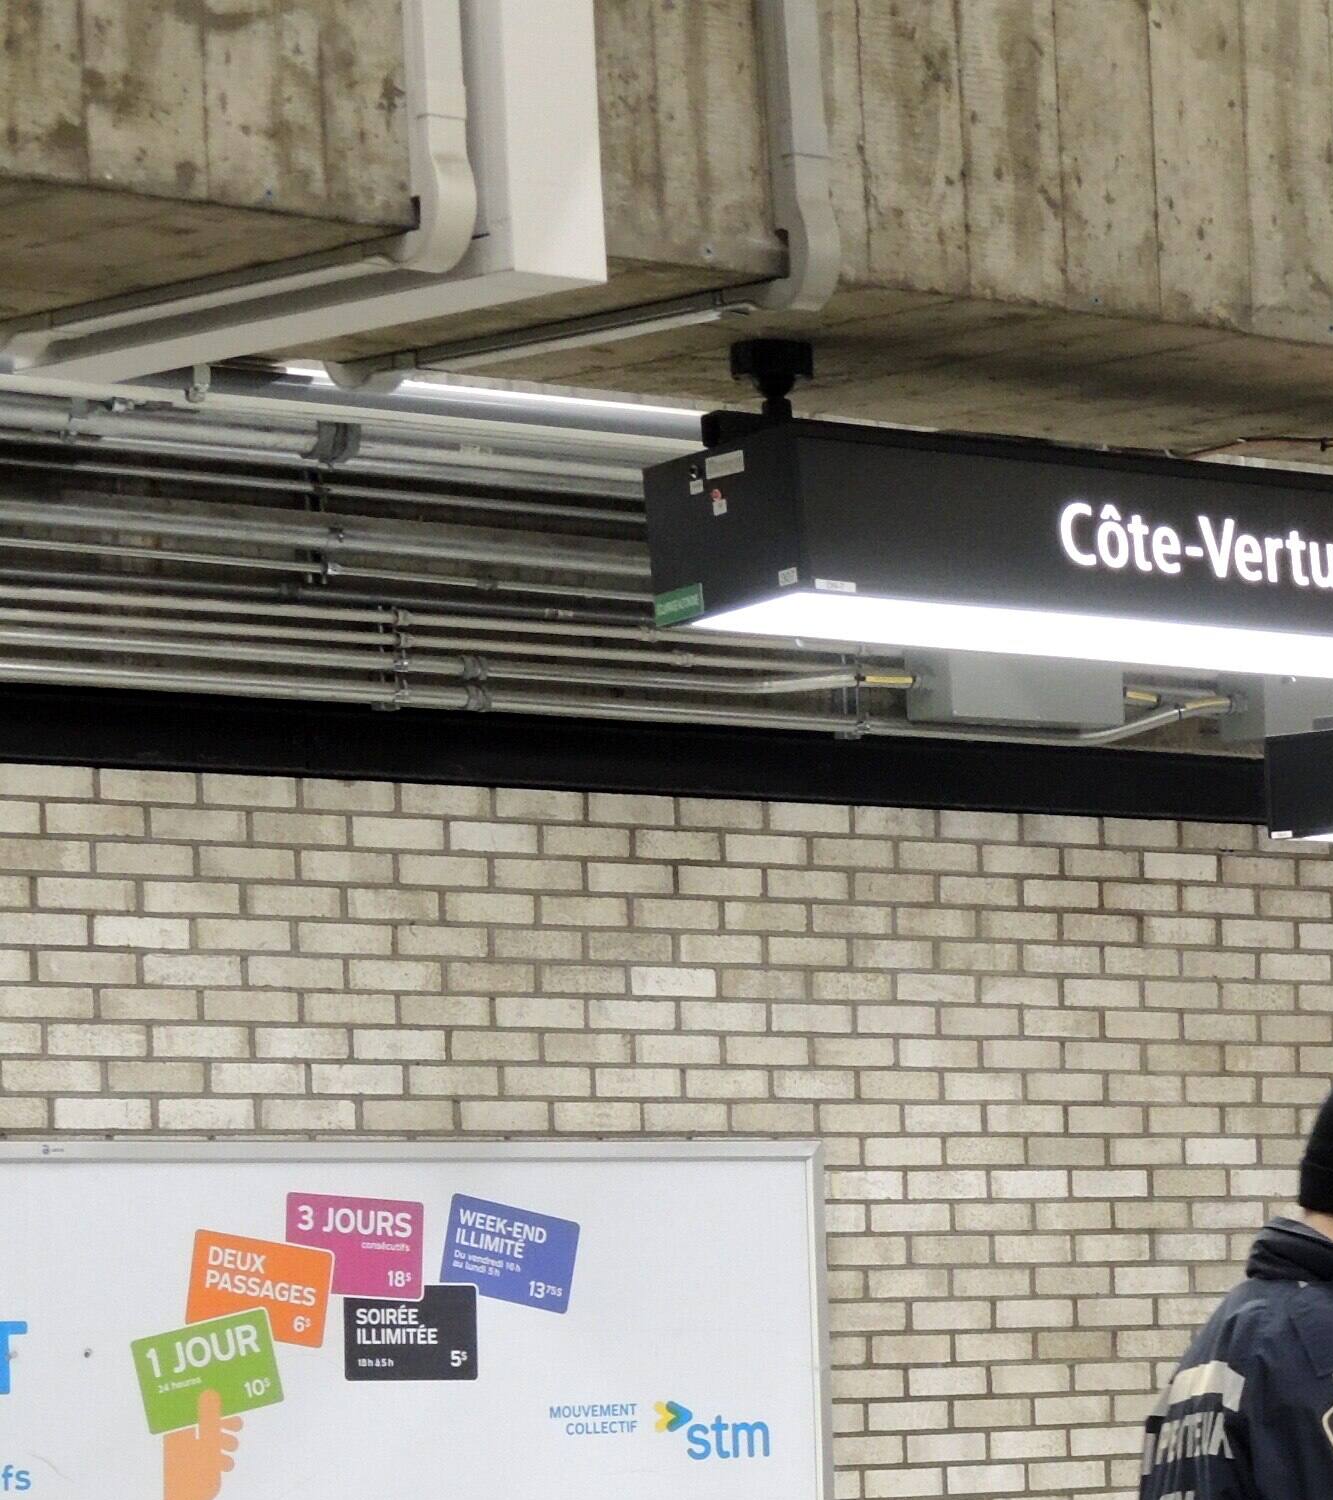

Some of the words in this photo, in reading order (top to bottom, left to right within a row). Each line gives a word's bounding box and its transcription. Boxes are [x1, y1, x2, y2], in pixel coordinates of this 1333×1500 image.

[297, 1204, 313, 1231] 3
[322, 1207, 412, 1238] JOURS
[459, 1208, 547, 1243] WEEK-END
[455, 1228, 525, 1259] ILLIMITÉ
[207, 1246, 266, 1274] DEUX
[205, 1269, 316, 1307] PASSAGES
[355, 1304, 419, 1325] SOIRÉE
[356, 1325, 438, 1345] ILLIMITÉE
[146, 1348, 161, 1378] 1
[173, 1324, 261, 1374] JOUR
[549, 1403, 637, 1419] MOUVEMENT
[566, 1420, 637, 1436] COLLECTIF
[686, 1414, 770, 1460] stm
